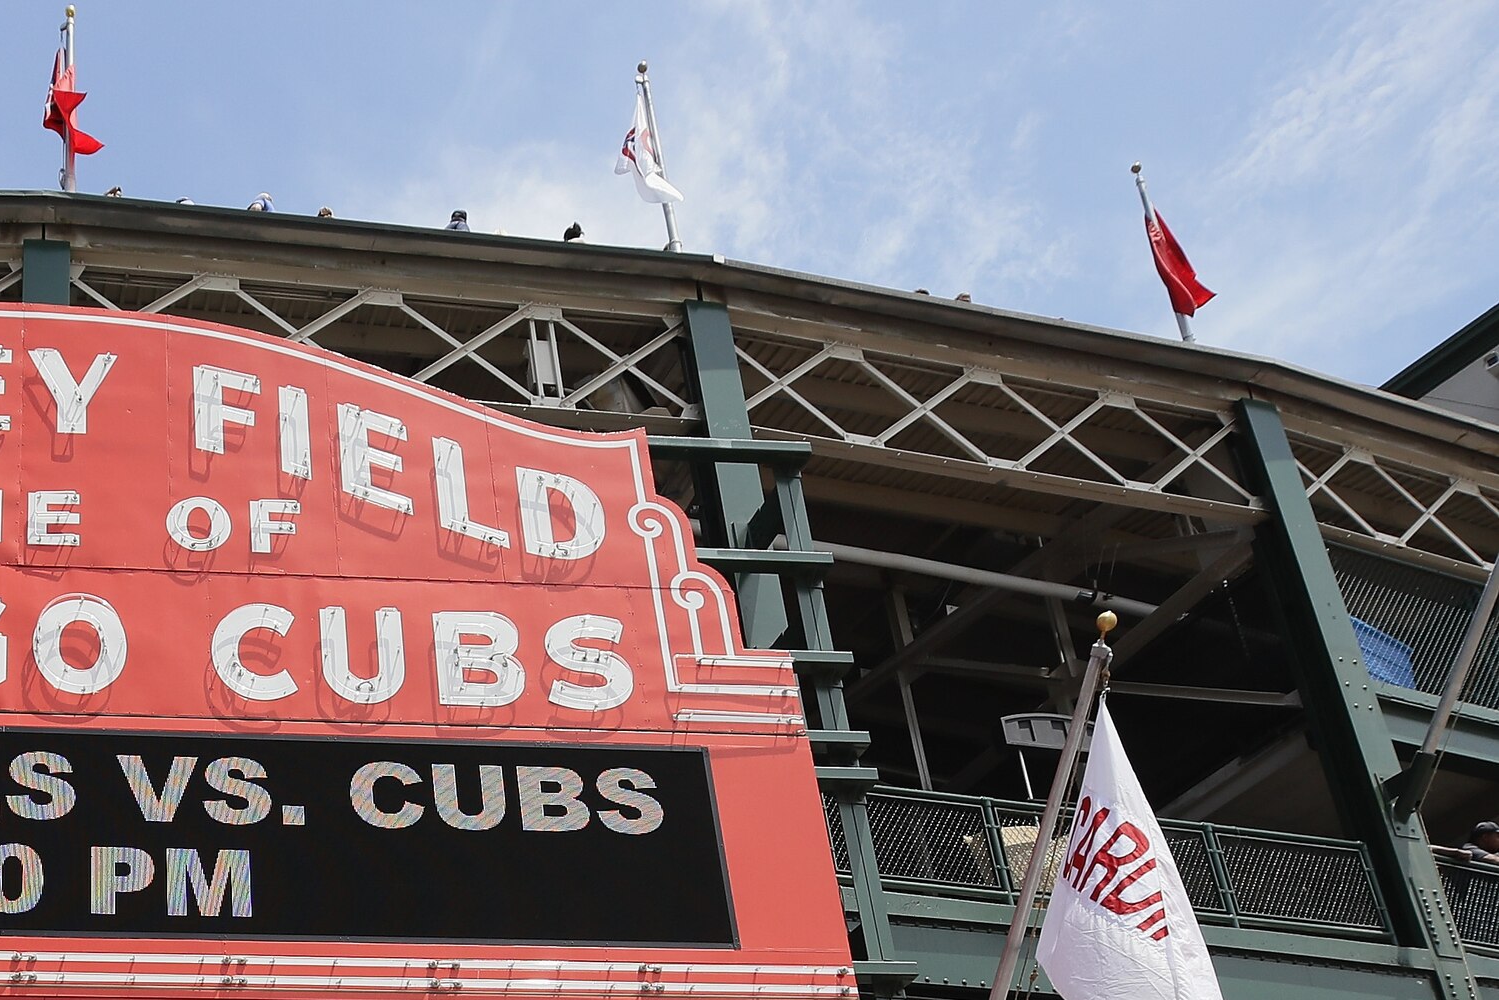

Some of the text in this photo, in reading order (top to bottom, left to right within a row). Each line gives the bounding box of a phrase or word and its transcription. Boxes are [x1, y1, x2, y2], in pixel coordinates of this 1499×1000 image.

[192, 364, 607, 561] FIELD
[165, 495, 301, 554] OF
[211, 603, 634, 711] CUBS
[117, 754, 306, 827] VS.
[349, 761, 665, 835] CUBS
[89, 846, 253, 918] PM
